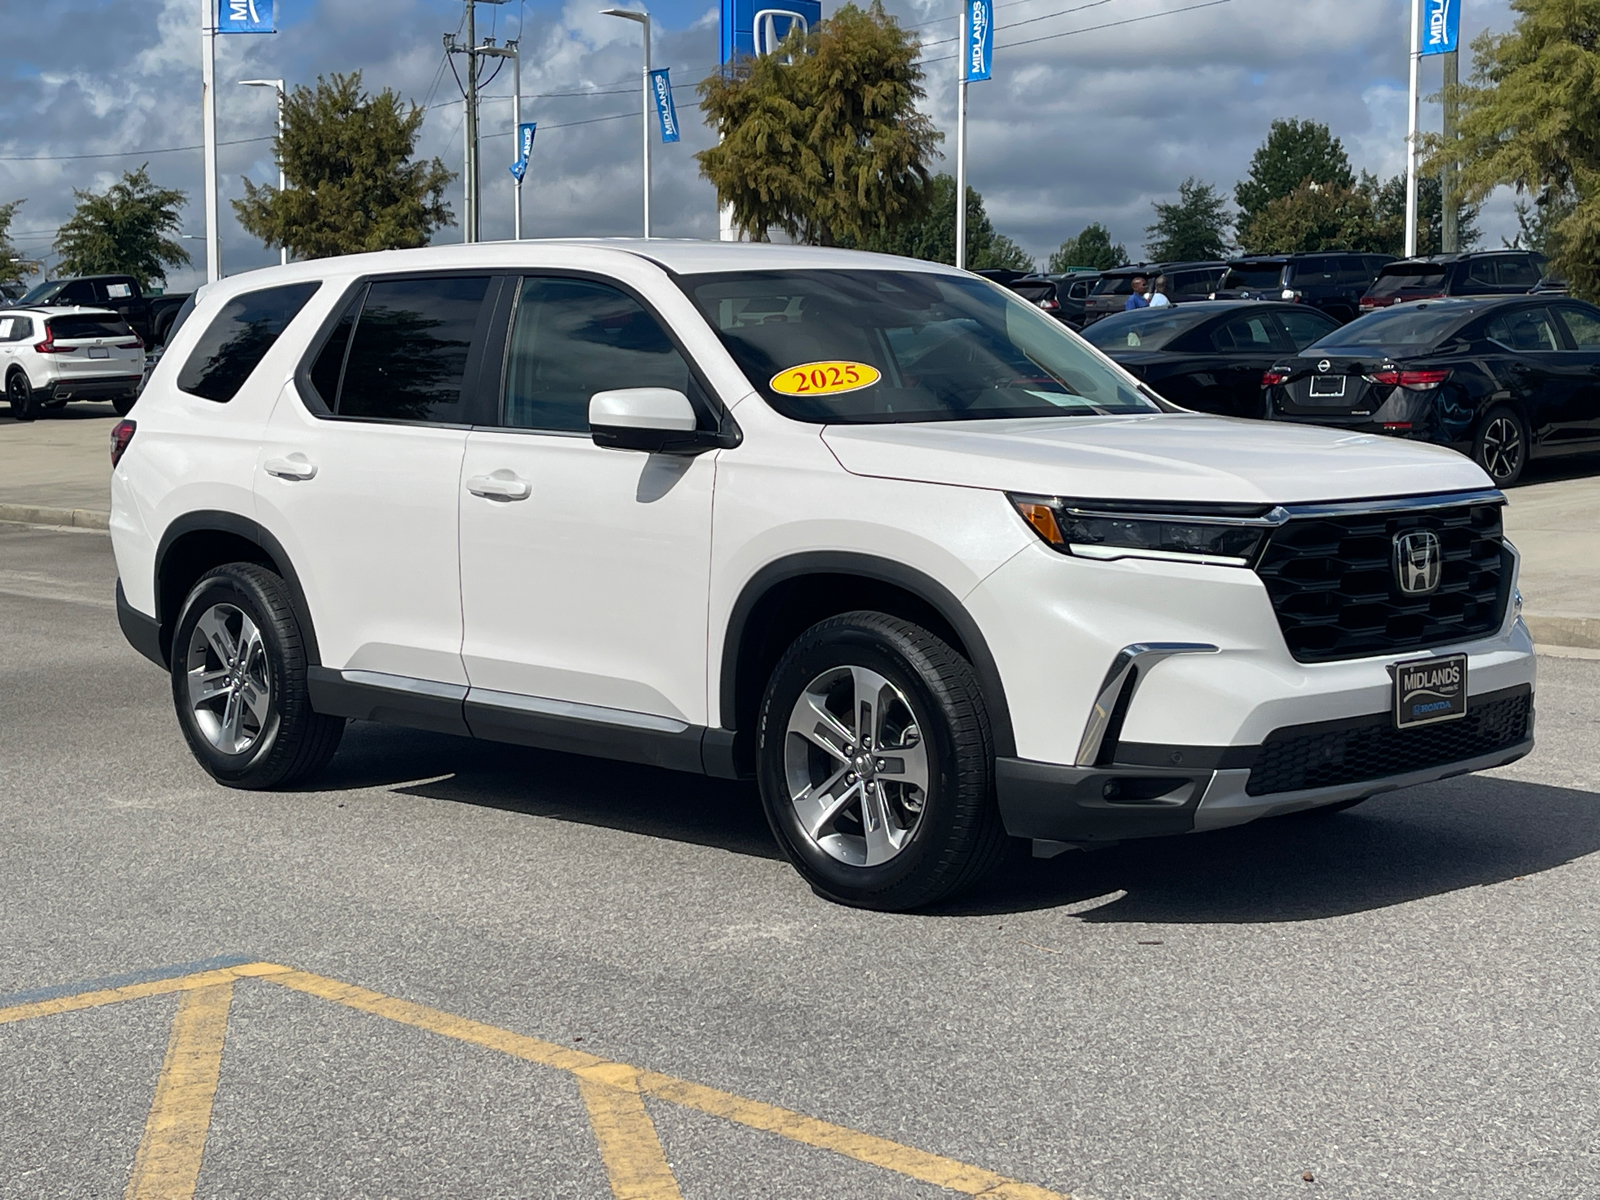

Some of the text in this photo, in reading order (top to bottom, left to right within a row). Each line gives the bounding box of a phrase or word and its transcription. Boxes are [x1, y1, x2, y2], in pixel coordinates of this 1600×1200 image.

[972, 0, 981, 73] MIDLANDS
[1430, 0, 1443, 44] MIDL
[655, 75, 673, 134] MIDLANDS
[792, 365, 860, 392] 2025
[1404, 666, 1460, 691] MIDLANDS
[1421, 700, 1452, 712] HONDA
